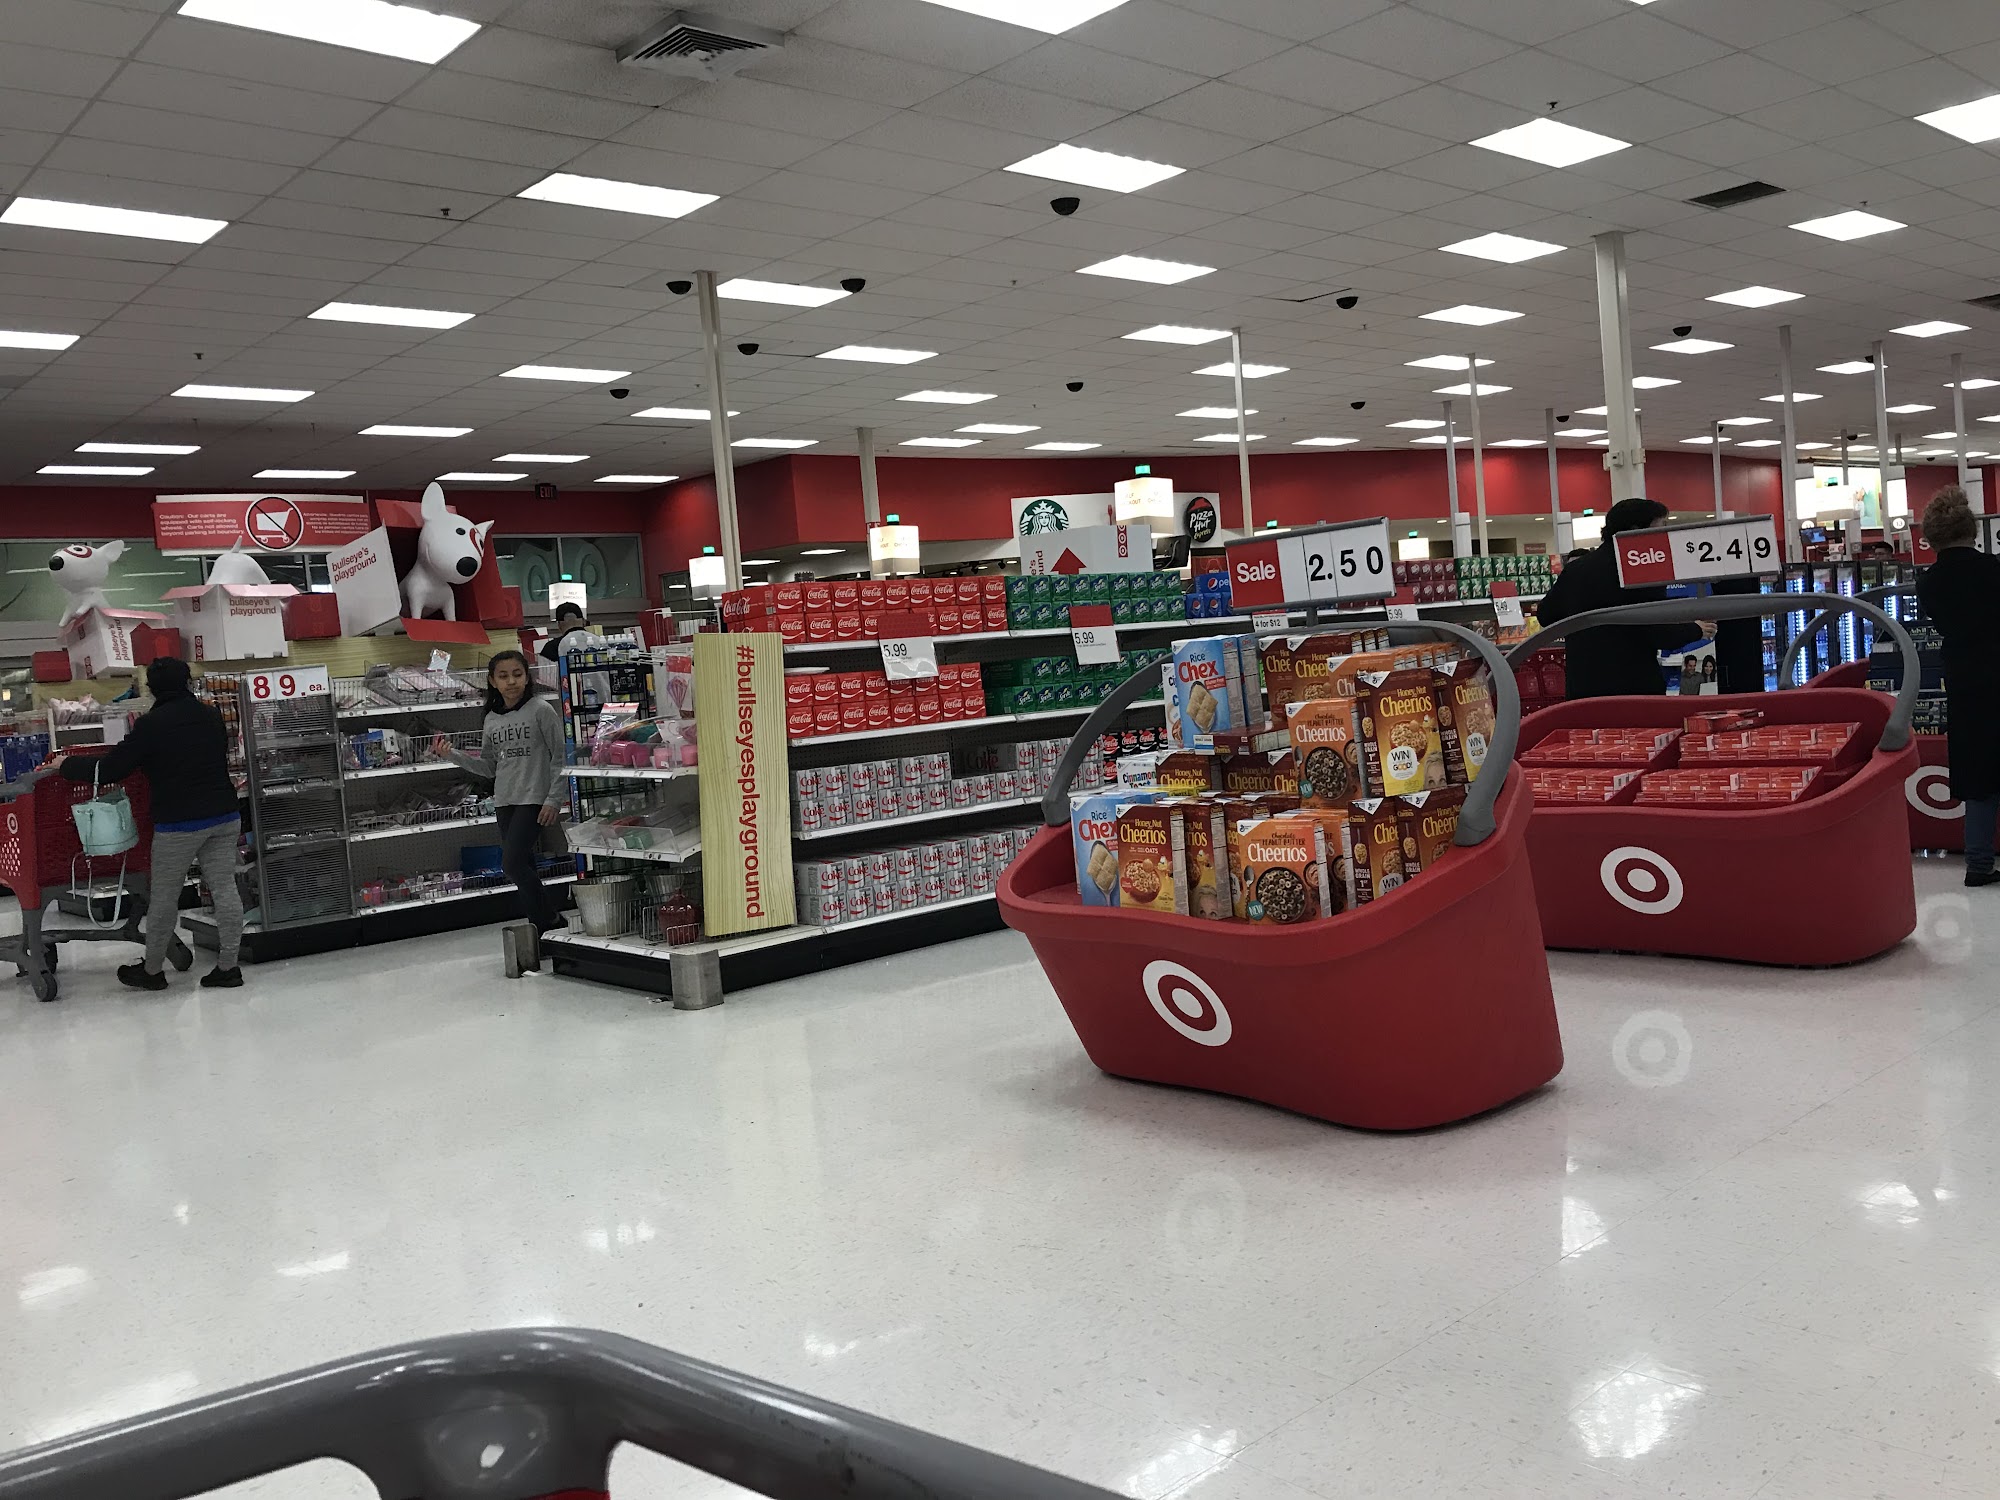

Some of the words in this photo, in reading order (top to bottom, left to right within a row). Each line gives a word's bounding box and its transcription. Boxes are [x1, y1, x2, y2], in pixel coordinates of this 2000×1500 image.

[540, 486, 554, 498] EXIT
[1190, 510, 1213, 528] Pizza
[1194, 519, 1211, 532] Hut
[1627, 548, 1665, 567] Sale
[1686, 537, 1770, 563] $2.49
[332, 547, 369, 572] bullseye's
[1236, 560, 1276, 583] Sale
[1309, 546, 1384, 581] 2.50
[334, 553, 376, 584] playground
[229, 597, 270, 606] bullseye's
[1496, 602, 1507, 611] 5.49
[230, 605, 277, 616] playground
[1389, 608, 1403, 619] 5.99
[1270, 618, 1281, 627] $12
[108, 622, 121, 660] bullseye's
[116, 619, 130, 661] playground
[1075, 632, 1094, 644] 5.99
[883, 644, 907, 657] 5.99
[1190, 653, 1206, 662] Rice
[1266, 656, 1291, 672] Chee
[1295, 660, 1329, 678] Cheer
[1179, 661, 1218, 682] Chex
[309, 683, 325, 691] ea.
[1397, 688, 1414, 697] Honey
[1455, 685, 1489, 705] Cheerios
[1380, 696, 1432, 717] Cheerios
[490, 727, 530, 744] ELIEVE
[1296, 725, 1346, 742] Cheerios
[1912, 727, 1938, 735] Advil
[1468, 737, 1481, 746] WIN
[1020, 749, 1037, 758] Coke
[1391, 751, 1410, 761] WIN
[929, 760, 948, 770] Coke
[1393, 762, 1413, 771] GOOD!
[853, 770, 874, 780] Coke
[878, 766, 897, 777] Coke
[1122, 770, 1157, 783] Cinnamon
[1174, 769, 1190, 778] Honey
[736, 644, 764, 919] #bullseyesplayground
[800, 777, 822, 787] Coke
[1022, 775, 1039, 784] Coke
[1161, 774, 1206, 787] Cheerios
[1228, 773, 1271, 790] Cheerio
[955, 785, 973, 795] Coke
[976, 782, 995, 791] Coke
[1300, 784, 1312, 793] NEW
[907, 792, 926, 802] Coke
[931, 788, 949, 798] Coke
[829, 803, 850, 813] Coke
[856, 799, 877, 809] Coke
[1091, 810, 1107, 820] Rice
[1437, 808, 1452, 816] Honey
[1135, 819, 1151, 828] Honey
[1423, 815, 1459, 838] Cheeri
[1078, 819, 1117, 842] Chex
[1120, 824, 1166, 845] Cheerios
[972, 843, 990, 854] Coke
[994, 839, 1012, 849] Coke
[924, 852, 944, 862] Coke
[1248, 843, 1308, 862] Cheerios
[898, 857, 919, 867] Coke
[848, 866, 868, 877] Coke
[974, 872, 992, 882] Coke
[925, 881, 945, 891] Coke
[1382, 877, 1398, 889] WIN
[902, 886, 921, 896] Coke
[850, 897, 871, 906] Coke
[1248, 904, 1263, 916] NEW
